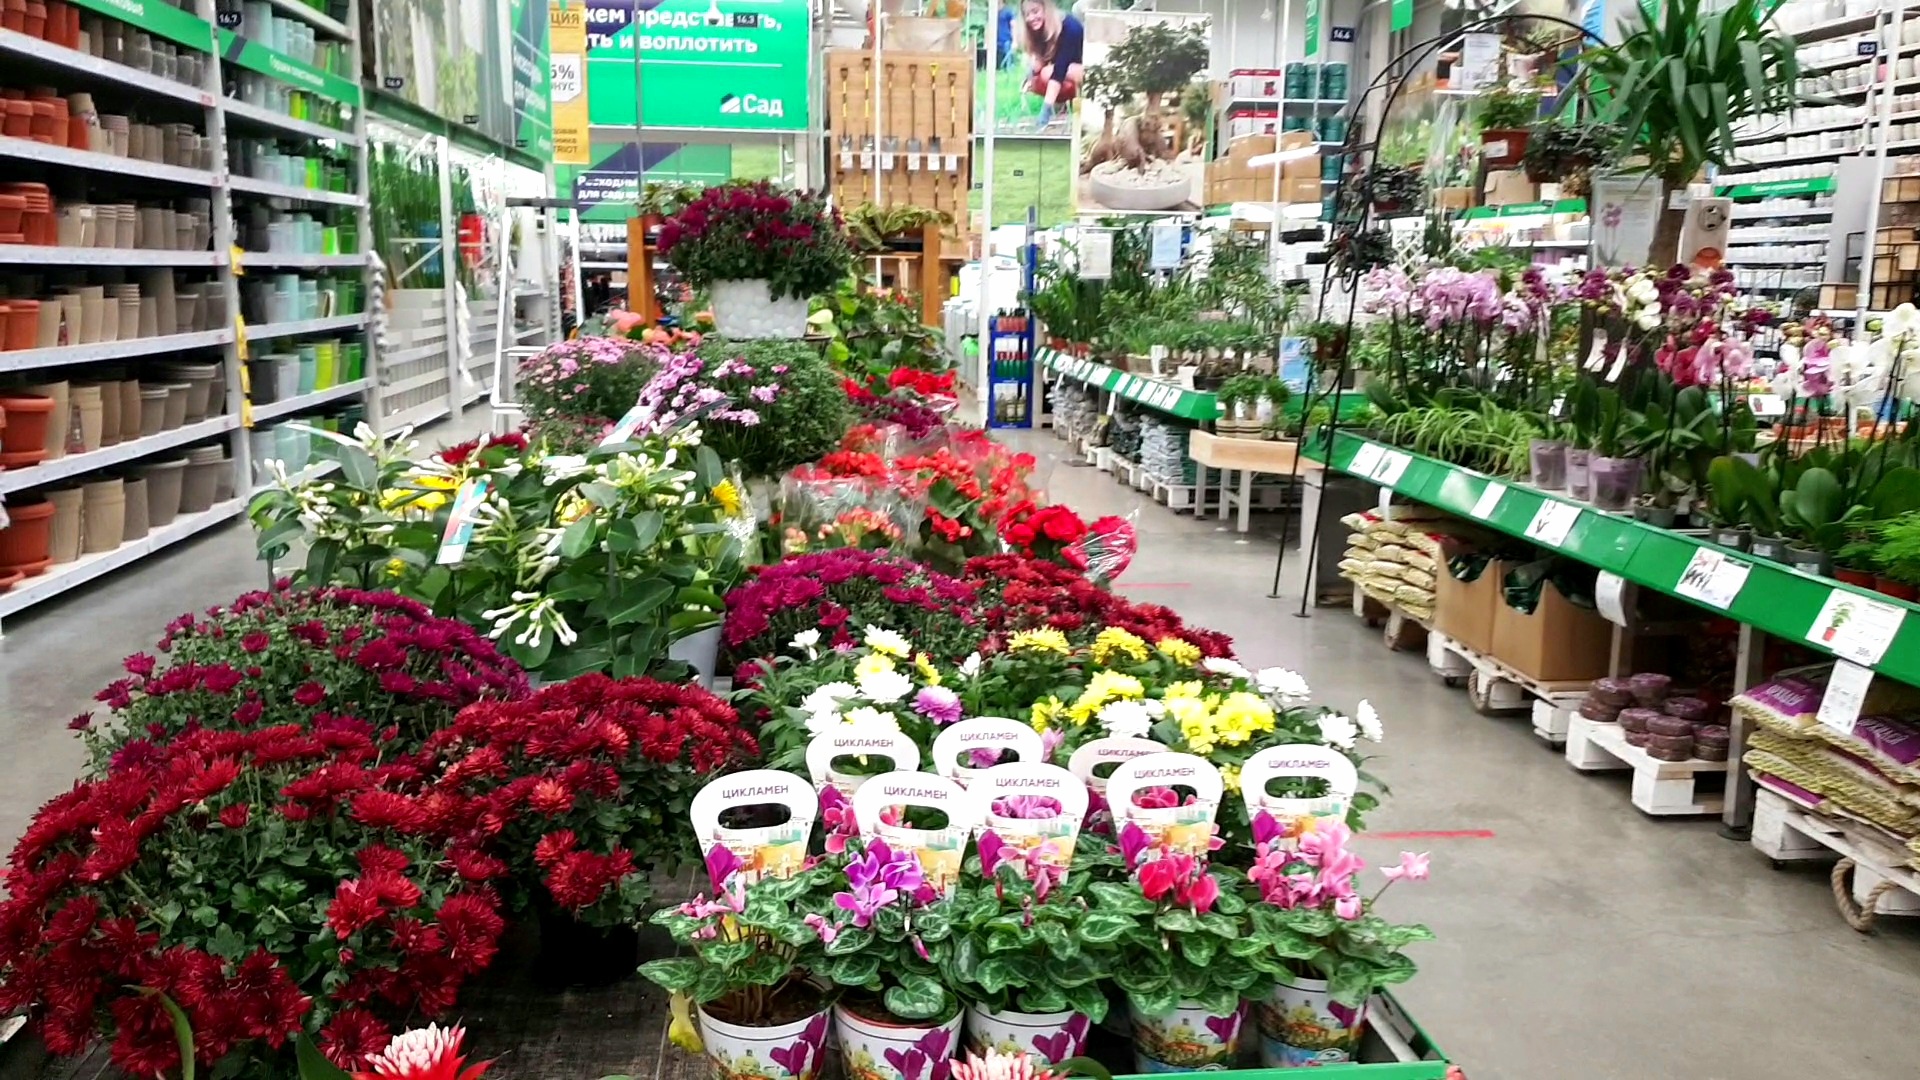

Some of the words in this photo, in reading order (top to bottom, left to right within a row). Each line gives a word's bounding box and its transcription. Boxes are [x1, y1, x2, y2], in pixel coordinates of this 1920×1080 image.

[218, 13, 238, 24] 16.7
[584, 33, 614, 48] ть
[619, 34, 634, 49] и
[639, 35, 758, 53] воплотить
[743, 93, 784, 117] Сад
[578, 189, 600, 200] для
[960, 732, 1019, 742] ЦИКЛАМЕН
[834, 739, 894, 748] ЦИКЛАМЕН
[1098, 748, 1151, 757] ЦИКЛАМ
[1268, 760, 1331, 769] ЦИКЛАМЕН
[1134, 767, 1196, 779] ЦИКЛАМЕН
[996, 778, 1060, 788] ЦИКЛАМЕН
[722, 784, 790, 799] ЦИКЛАМЕН
[883, 786, 948, 799] ЦИКЛАМЕН
